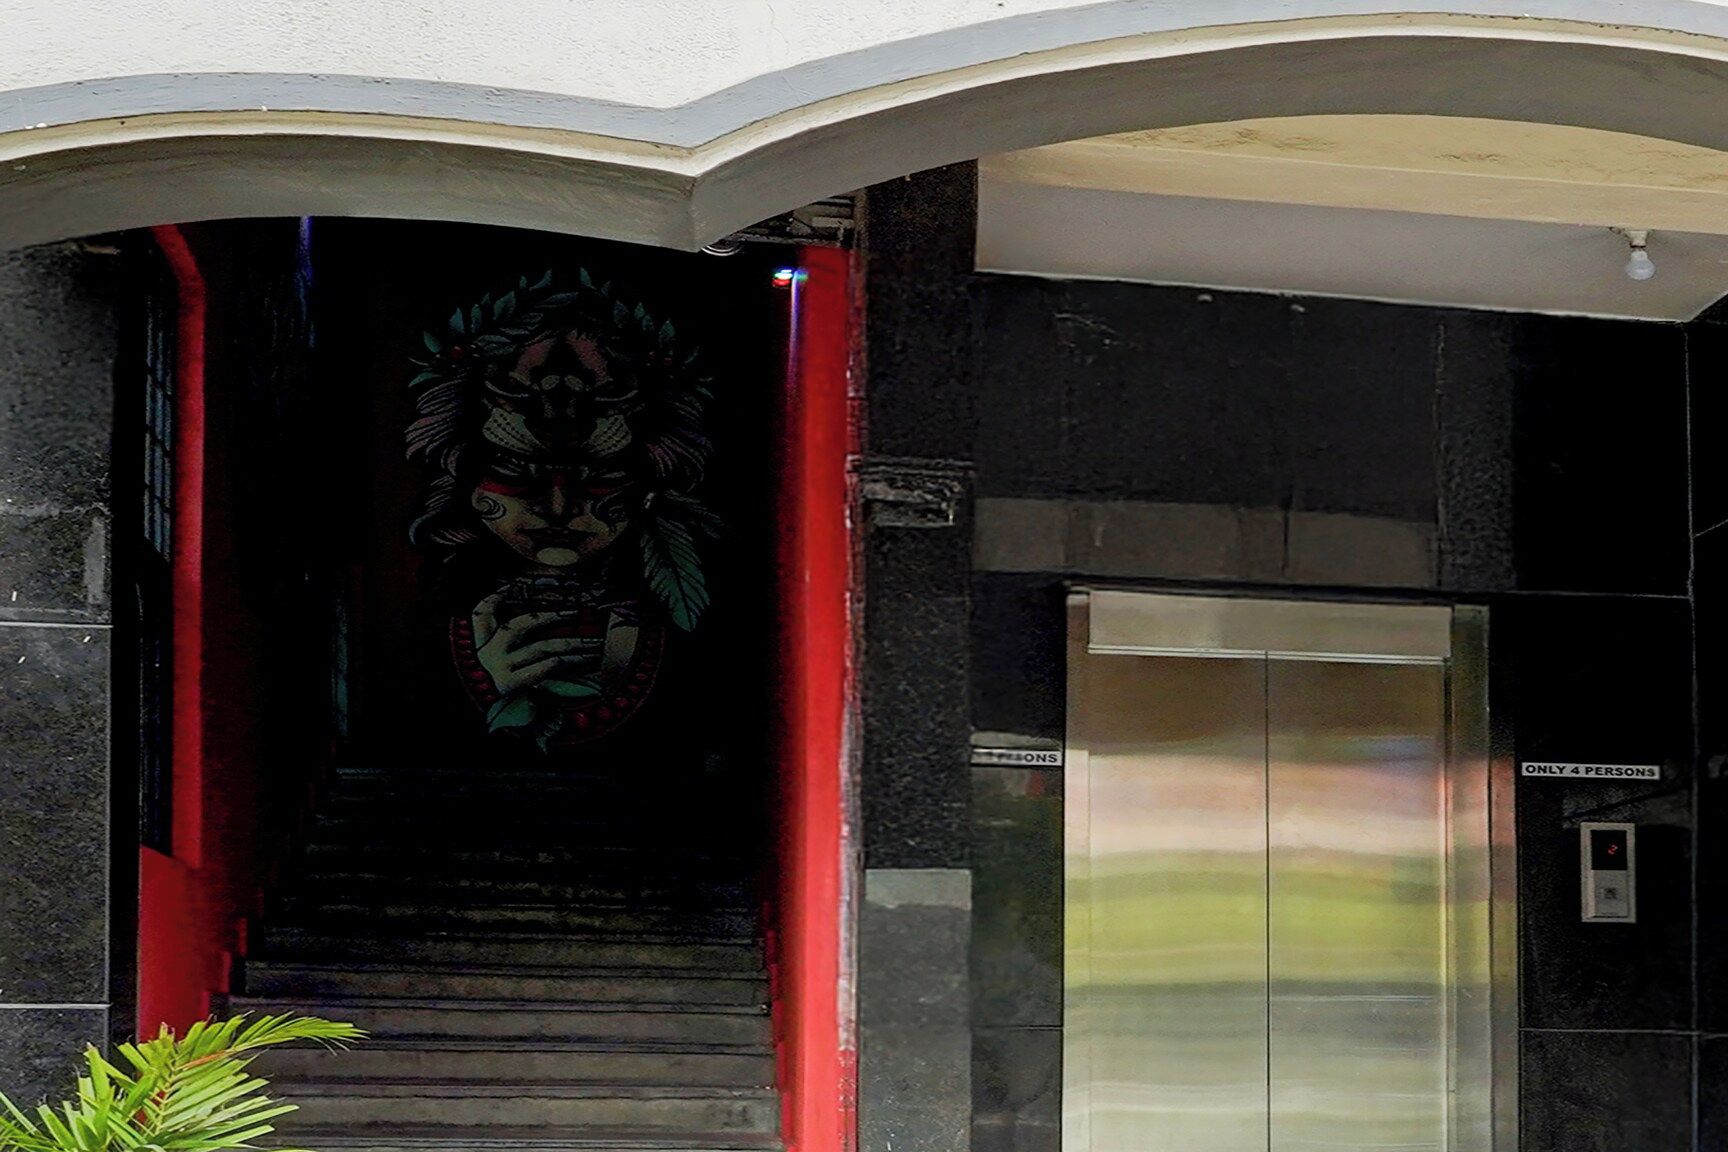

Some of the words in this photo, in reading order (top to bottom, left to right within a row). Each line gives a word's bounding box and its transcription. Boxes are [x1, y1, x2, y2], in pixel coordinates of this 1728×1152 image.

[1525, 764, 1566, 775] ONLY
[1570, 765, 1580, 775] 4
[1584, 766, 1656, 778] PERSONS
